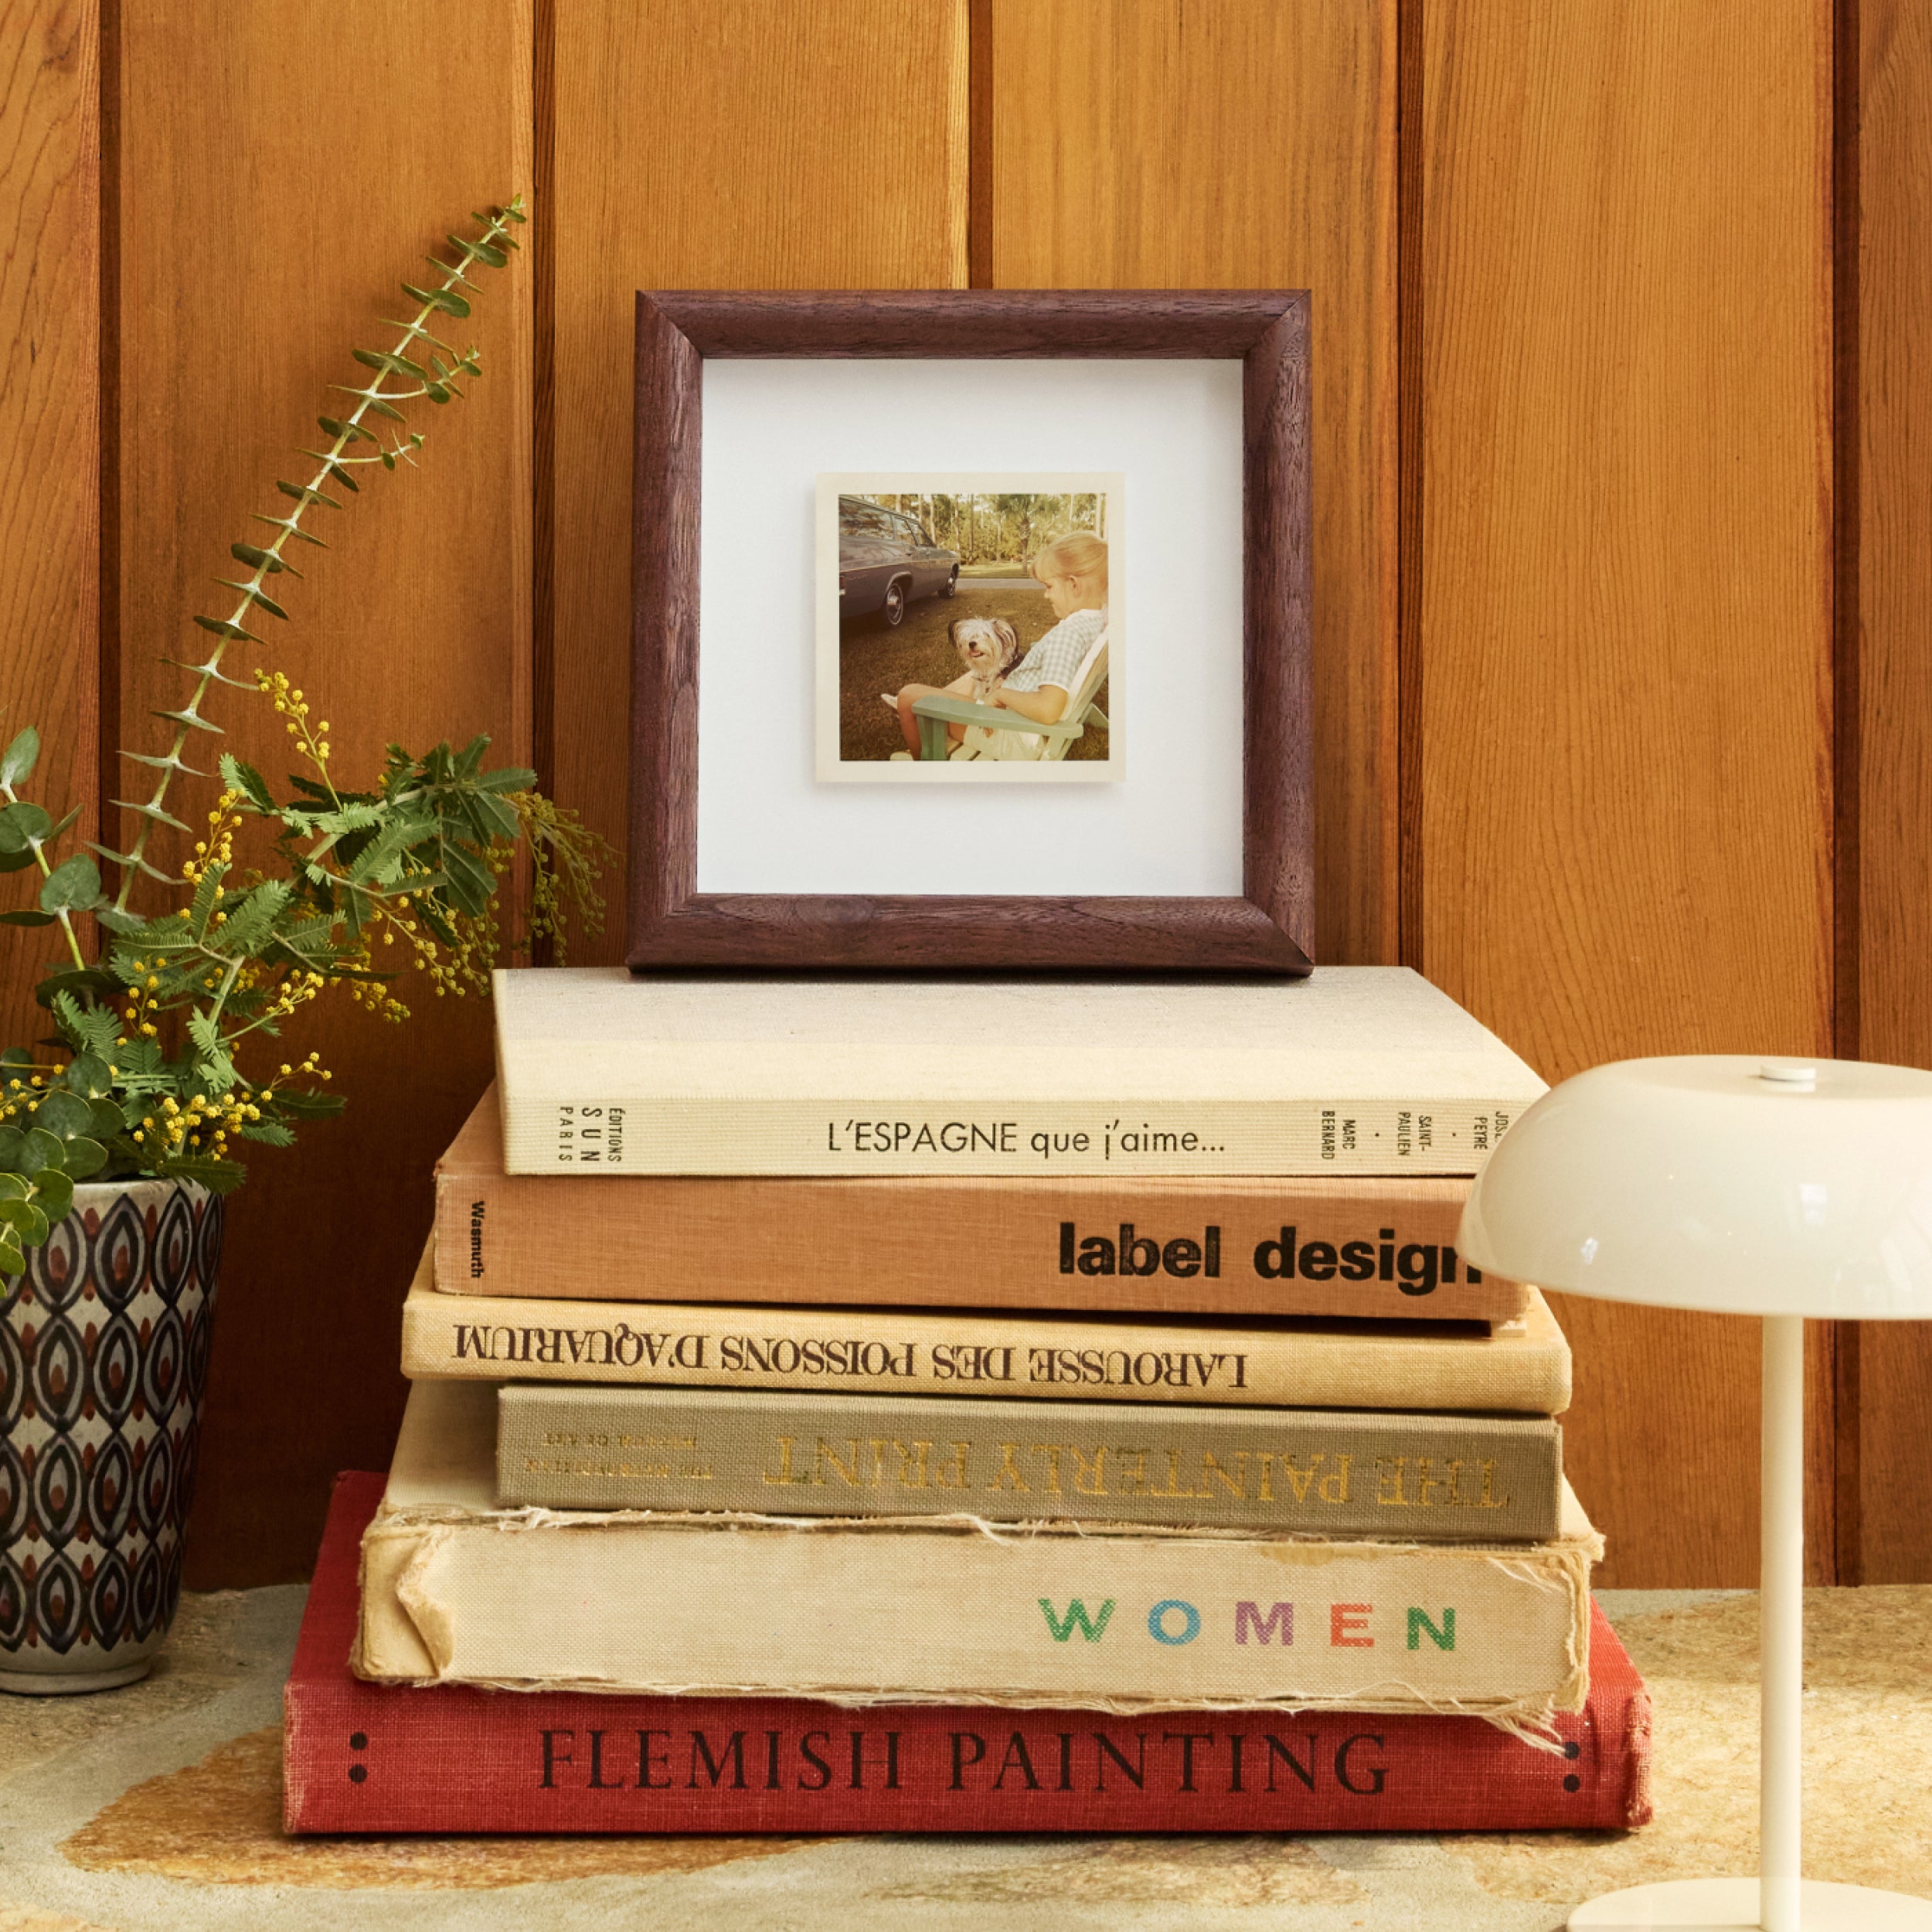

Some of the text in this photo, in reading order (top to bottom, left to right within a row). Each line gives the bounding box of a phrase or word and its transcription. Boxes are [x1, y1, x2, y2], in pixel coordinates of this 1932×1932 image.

[559, 1106, 573, 1162] PARIS
[580, 1107, 603, 1162] SUN
[828, 1120, 1017, 1152] L'ESPAGNE
[1030, 1132, 1090, 1158] que
[1321, 1111, 1335, 1160] BERNARD
[1342, 1119, 1355, 1150] MARC
[1397, 1111, 1411, 1157] PAULIEN
[471, 1200, 485, 1279] Wasmuth
[1059, 1221, 1221, 1280] label
[452, 1322, 1248, 1388] LAROUSSE DES POISSONS D'AQUARIUM
[763, 1437, 971, 1490] PRINT
[986, 1442, 1353, 1504] PAINTERLY
[1376, 1456, 1509, 1509] THE
[1037, 1598, 1456, 1651] WOMEN
[538, 1729, 1389, 1796] FLEMISH PAINTING
